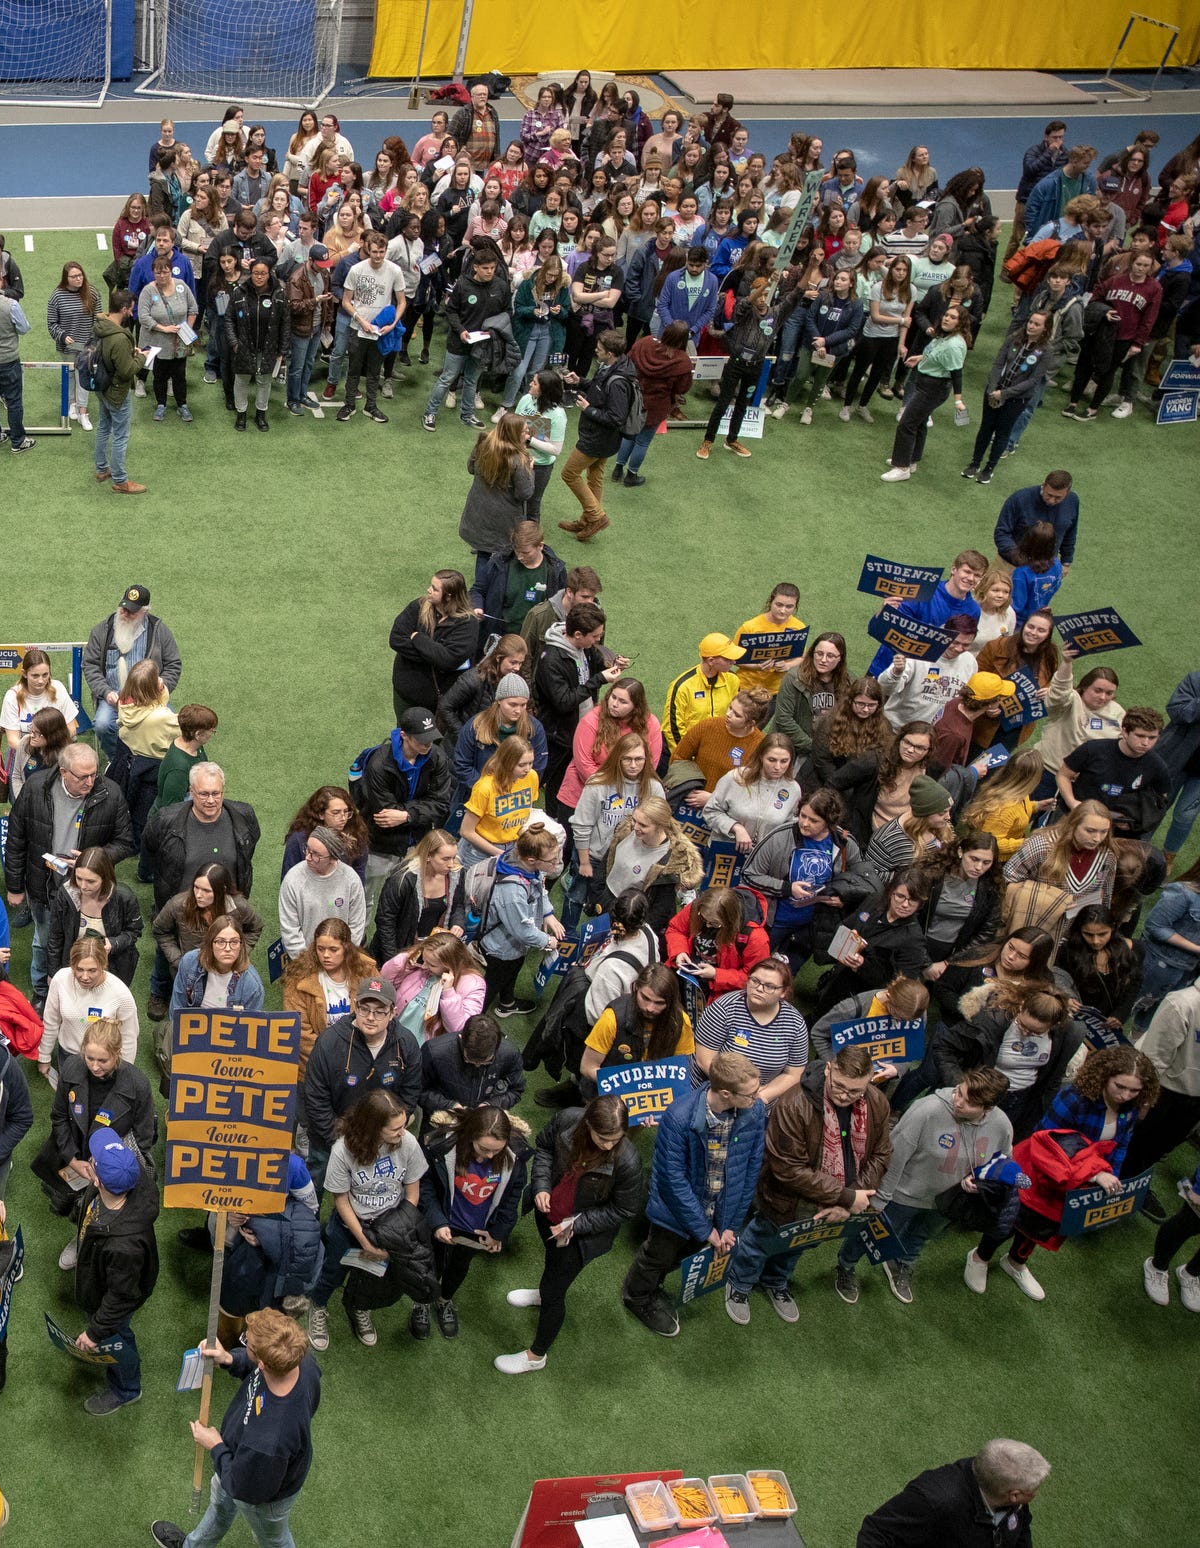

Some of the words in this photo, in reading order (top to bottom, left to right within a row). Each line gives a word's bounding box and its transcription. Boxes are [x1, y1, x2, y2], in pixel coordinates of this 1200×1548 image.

[1106, 289, 1132, 303] ALPHA
[1132, 293, 1147, 311] PHI
[1165, 403, 1192, 413] YANG
[1167, 397, 1193, 406] ANDREW
[866, 562, 940, 583] STUDENTS
[893, 576, 906, 584] FOR
[878, 581, 917, 597] PETE
[883, 611, 953, 645] STUDENTS
[1056, 614, 1119, 635] STUDENTS
[741, 632, 808, 647] STUDENTS
[888, 633, 926, 654] PETE
[906, 631, 919, 641] FOR
[1078, 632, 1116, 648] PETE
[755, 647, 789, 659] PETE
[1002, 696, 1019, 714] ETE
[498, 788, 532, 814] PETE
[683, 825, 710, 843] PET
[713, 856, 732, 885] PETE
[178, 1013, 296, 1055] PETE
[871, 1033, 886, 1041] FOR
[870, 1040, 902, 1057] ETE
[211, 1058, 264, 1078] Iowa
[601, 1065, 687, 1093] STUDENTS
[175, 1079, 291, 1123] PETE
[625, 1092, 671, 1111] PETE
[206, 1126, 258, 1144] Iowa
[171, 1145, 284, 1185] PETE
[202, 1189, 254, 1207] Iowa
[1106, 1197, 1120, 1205] FOR
[1088, 1204, 1130, 1223] PETE
[794, 1227, 842, 1245] PETE
